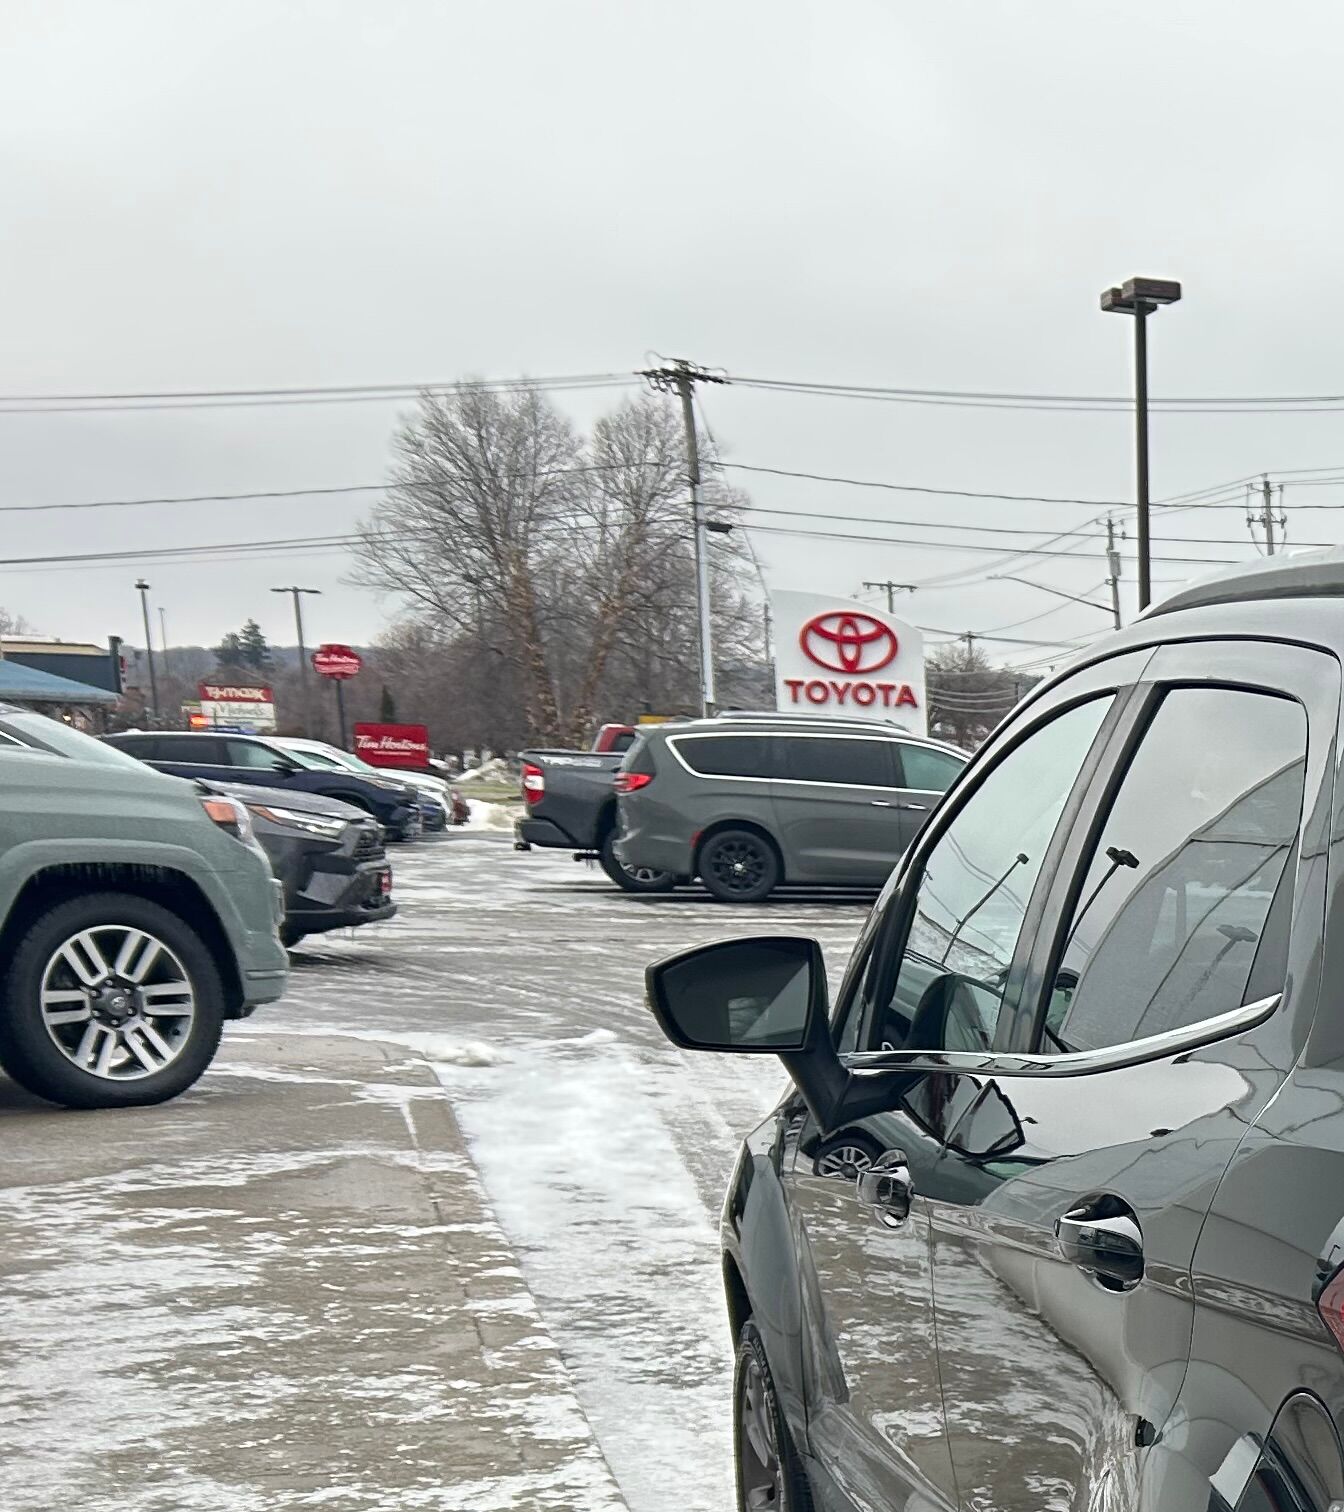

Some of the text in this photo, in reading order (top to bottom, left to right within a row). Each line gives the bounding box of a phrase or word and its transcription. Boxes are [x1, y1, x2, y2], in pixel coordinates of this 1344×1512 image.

[784, 680, 918, 708] TOYOTA
[356, 735, 427, 751] Tim Hortons
